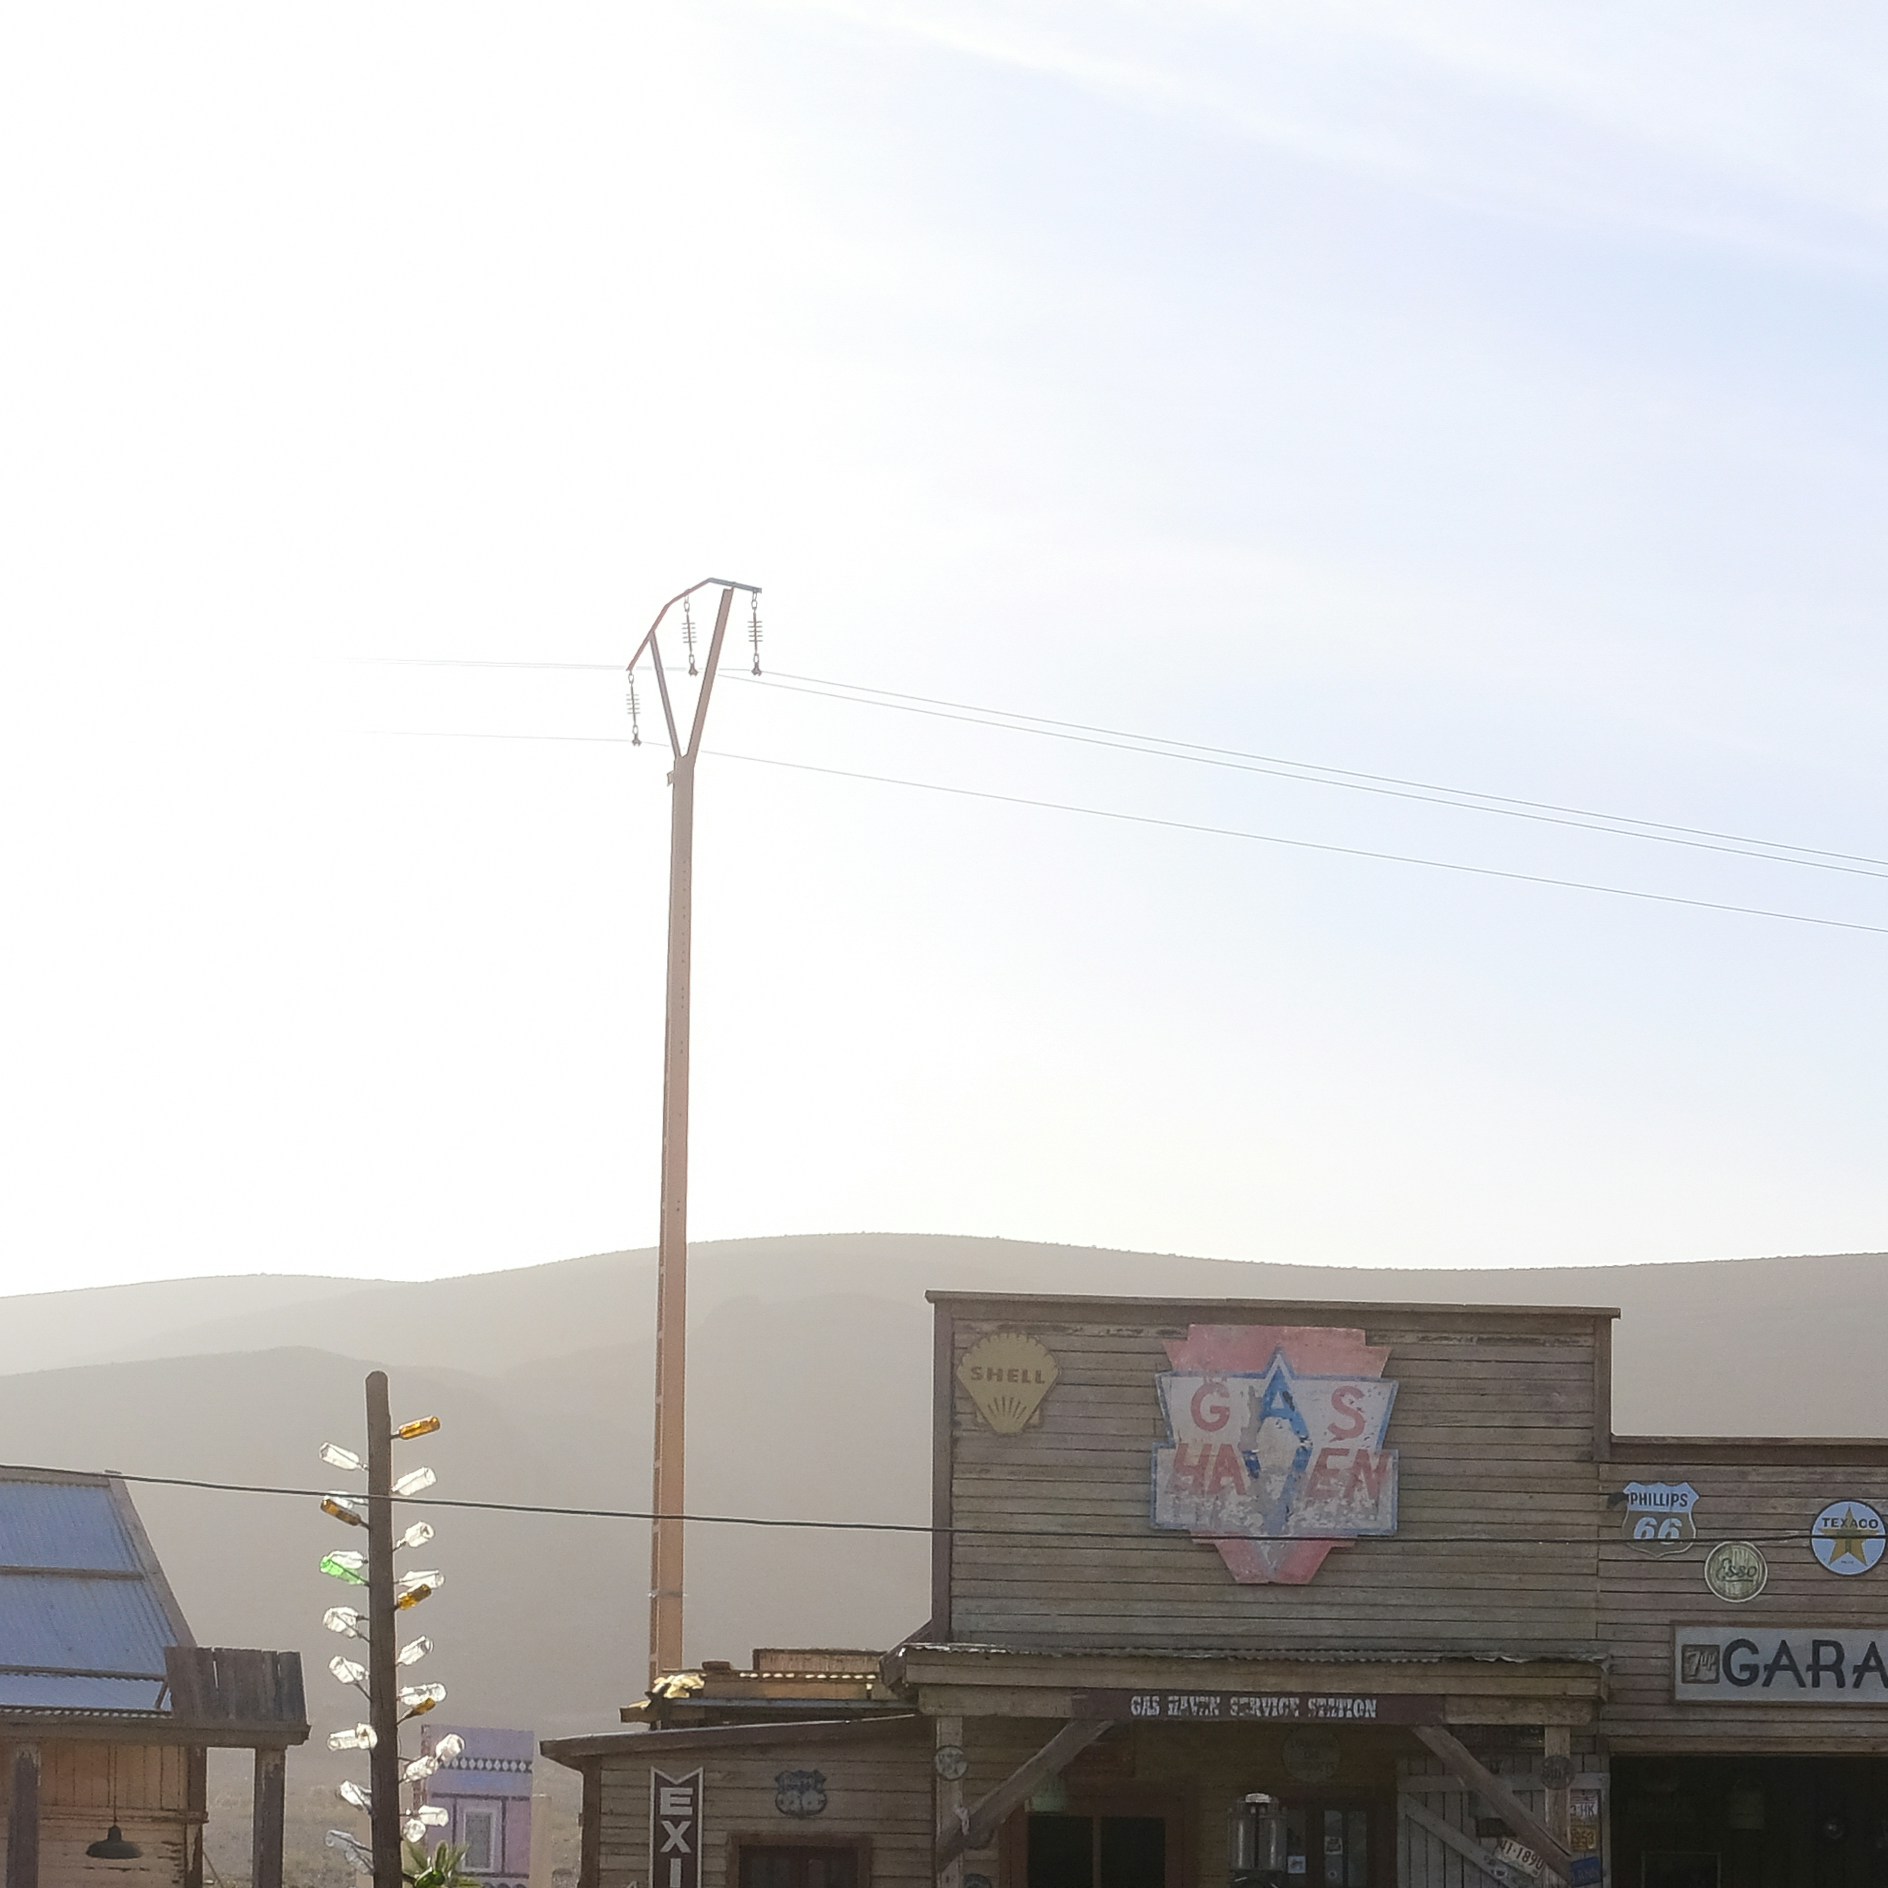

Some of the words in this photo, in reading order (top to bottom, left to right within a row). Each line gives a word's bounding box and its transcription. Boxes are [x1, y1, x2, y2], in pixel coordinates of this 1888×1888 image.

[970, 1365, 1045, 1385] SHELL
[1190, 1366, 1366, 1440] GAS
[1629, 1491, 1688, 1508] PHILLIPS
[1633, 1516, 1683, 1546] 66
[1821, 1517, 1879, 1529] TEXACO
[1716, 1557, 1758, 1583] Esso
[1130, 1695, 1160, 1717] GAS
[1167, 1695, 1221, 1717] HAVEN
[1229, 1697, 1300, 1718] SERVICE
[1308, 1697, 1377, 1719] STATION
